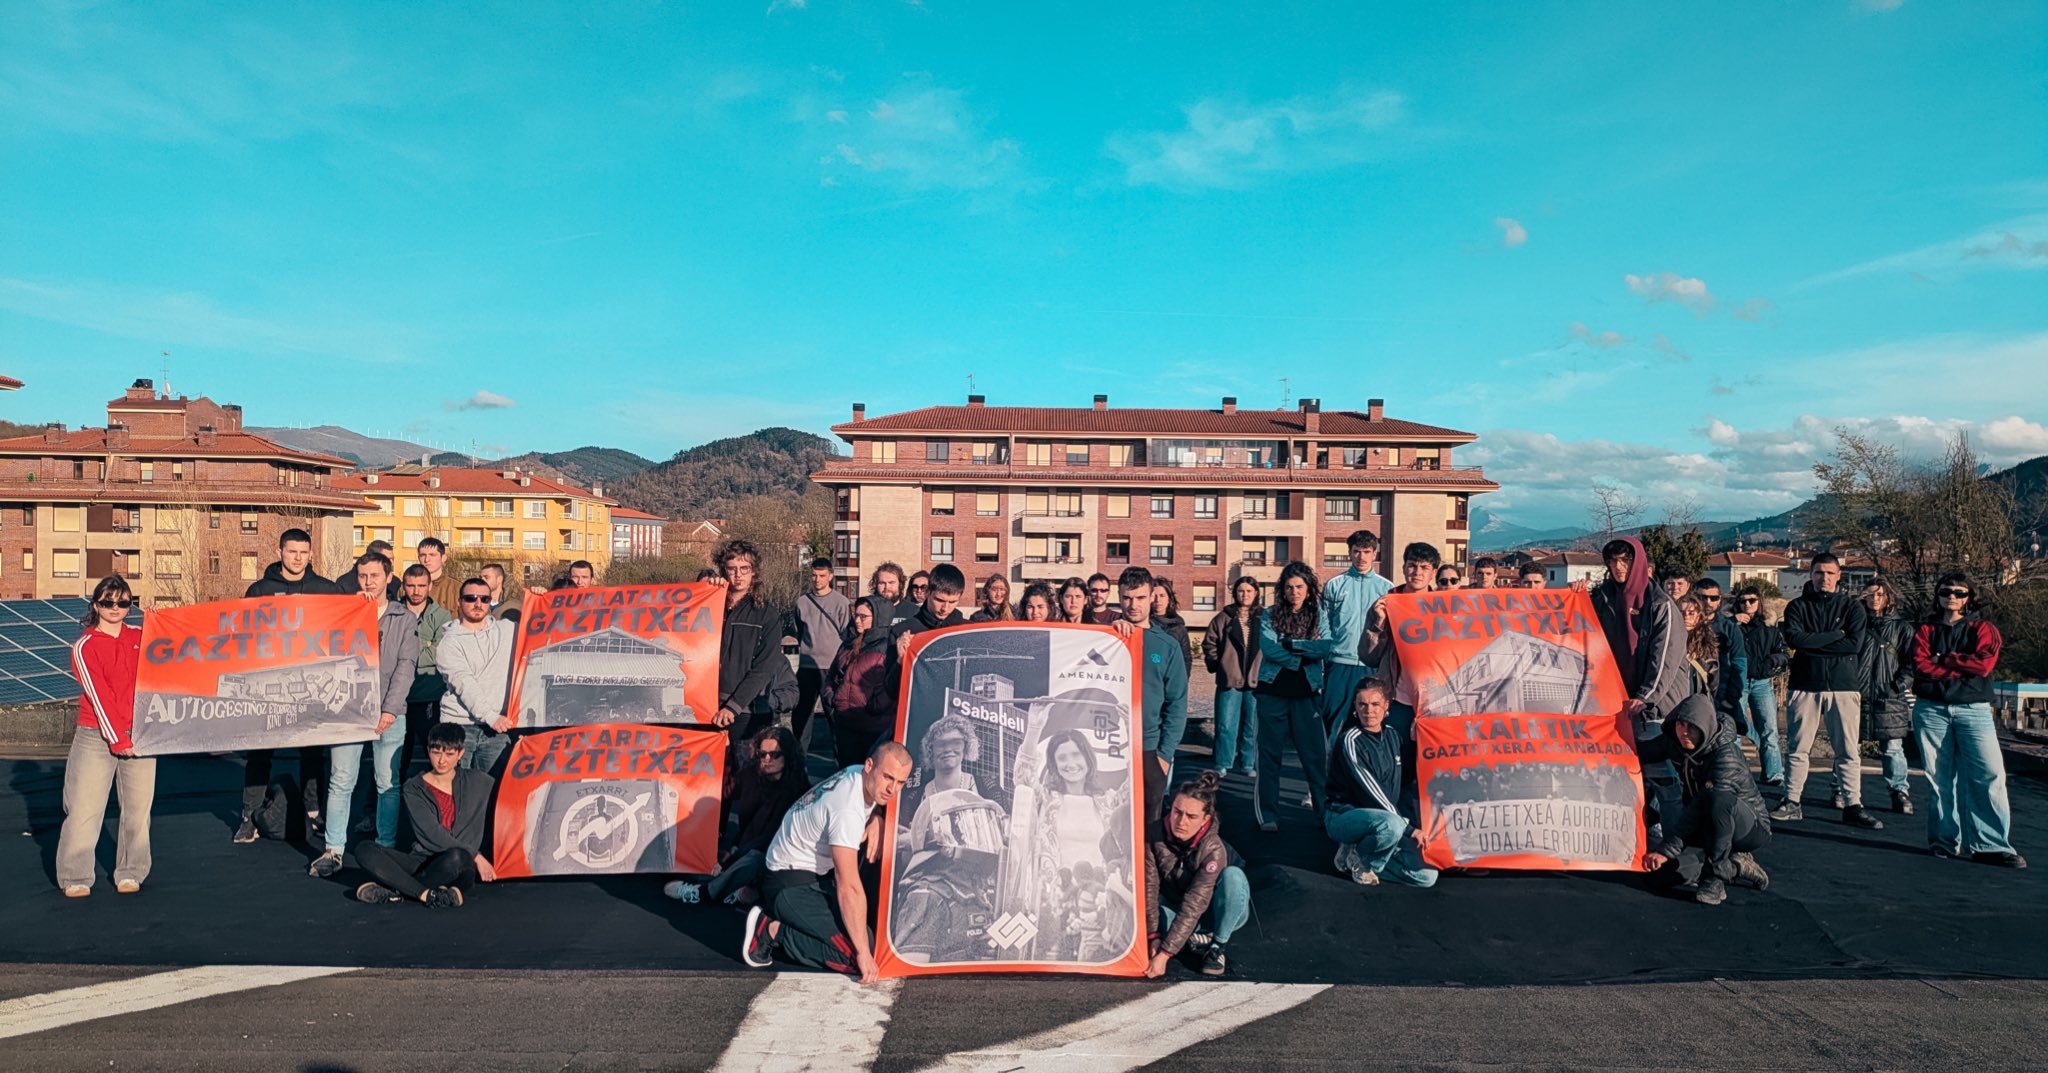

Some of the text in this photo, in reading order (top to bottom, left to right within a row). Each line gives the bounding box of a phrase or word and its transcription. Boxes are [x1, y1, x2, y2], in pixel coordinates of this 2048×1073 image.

[551, 588, 692, 608] BURLATAKO
[1417, 592, 1566, 616] MATRAILU
[219, 603, 304, 632] KIÑU
[526, 605, 715, 636] GAZTETXEA
[1398, 611, 1598, 644] GAZTETXEA
[145, 628, 373, 664] GAZTETXEA
[1058, 671, 1126, 684] AMENABAR
[960, 700, 1025, 734] Sabadell
[1465, 718, 1592, 741] KALETIK
[550, 730, 684, 749] ETXARRI 2
[1108, 719, 1125, 759] pnv
[1422, 741, 1536, 760] GAZTETXERA
[511, 748, 716, 779] GAZTETXEA
[575, 786, 629, 798] ETXARRI
[1453, 802, 1630, 833] GAZTETXEA AURRERA
[1479, 829, 1610, 856] UDALA ERRUDUN
